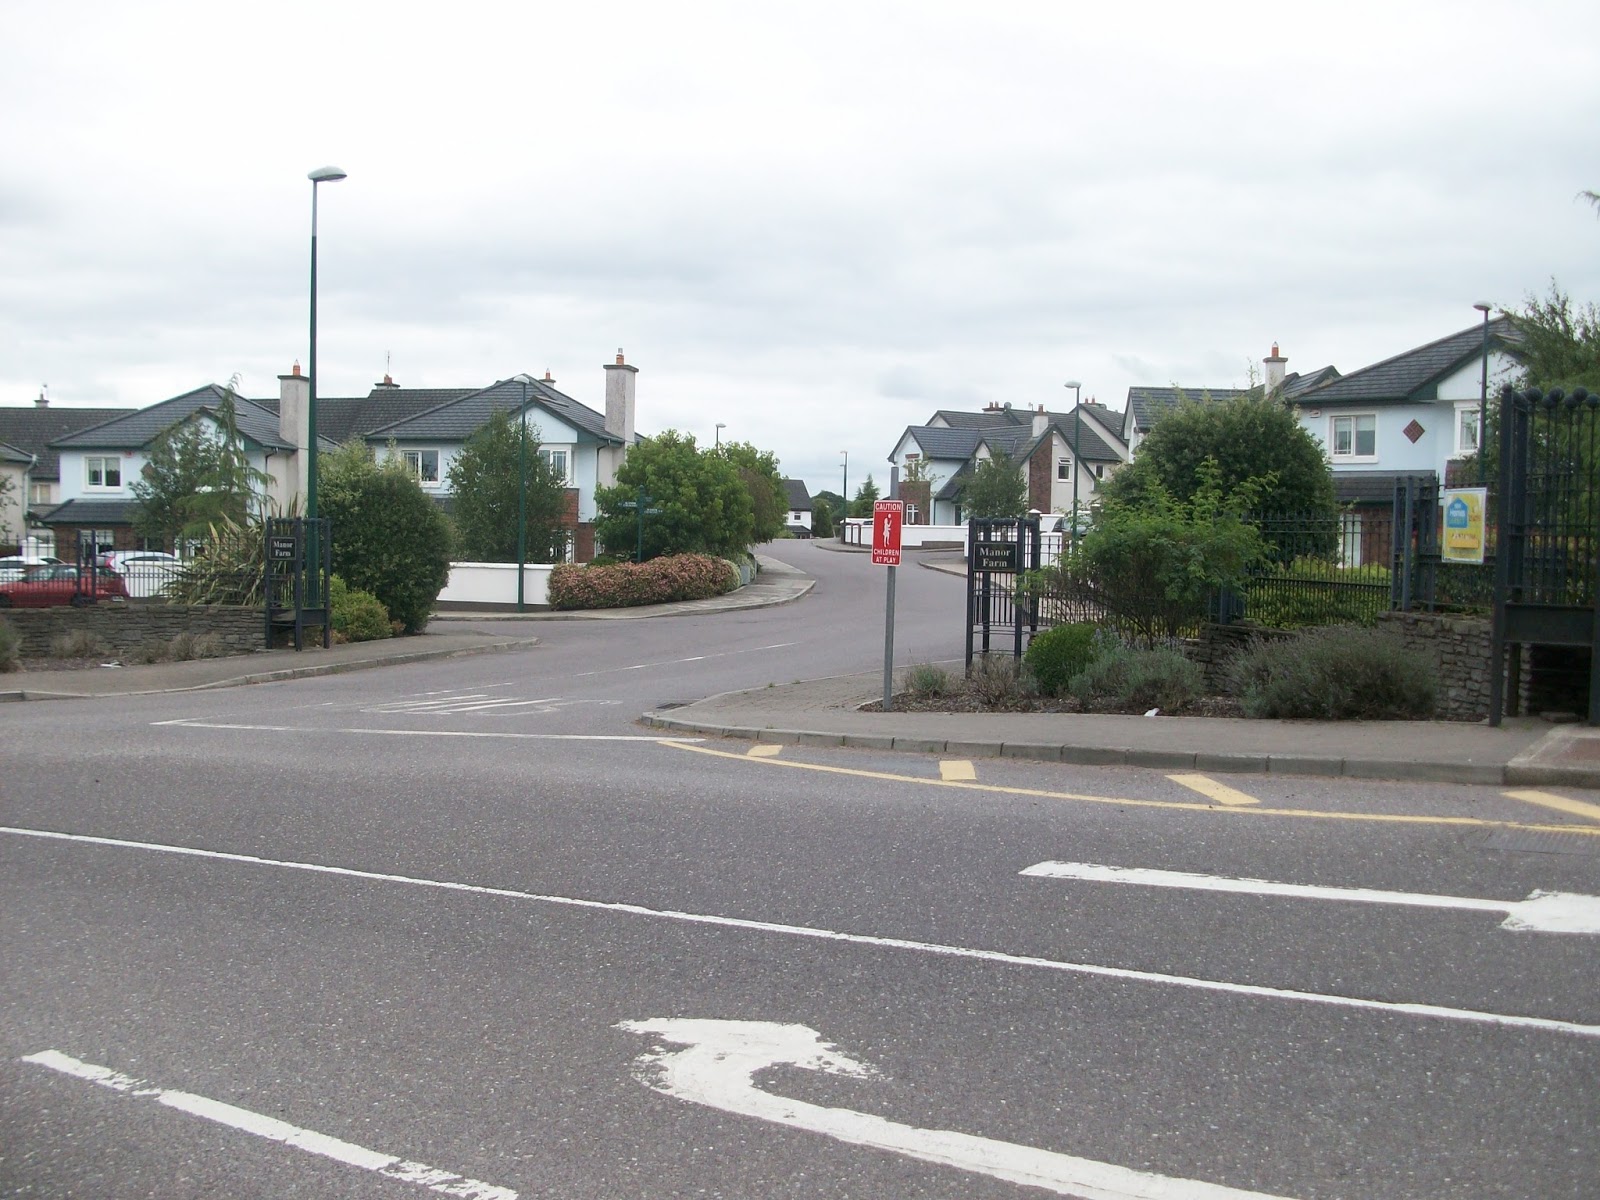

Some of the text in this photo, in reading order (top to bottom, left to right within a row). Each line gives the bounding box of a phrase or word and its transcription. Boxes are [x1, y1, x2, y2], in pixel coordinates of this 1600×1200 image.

[875, 503, 901, 511] CAUTION
[275, 549, 291, 557] Farm
[873, 548, 899, 556] CHILDREN
[979, 547, 1011, 556] Manor
[982, 558, 1008, 567] Farm
